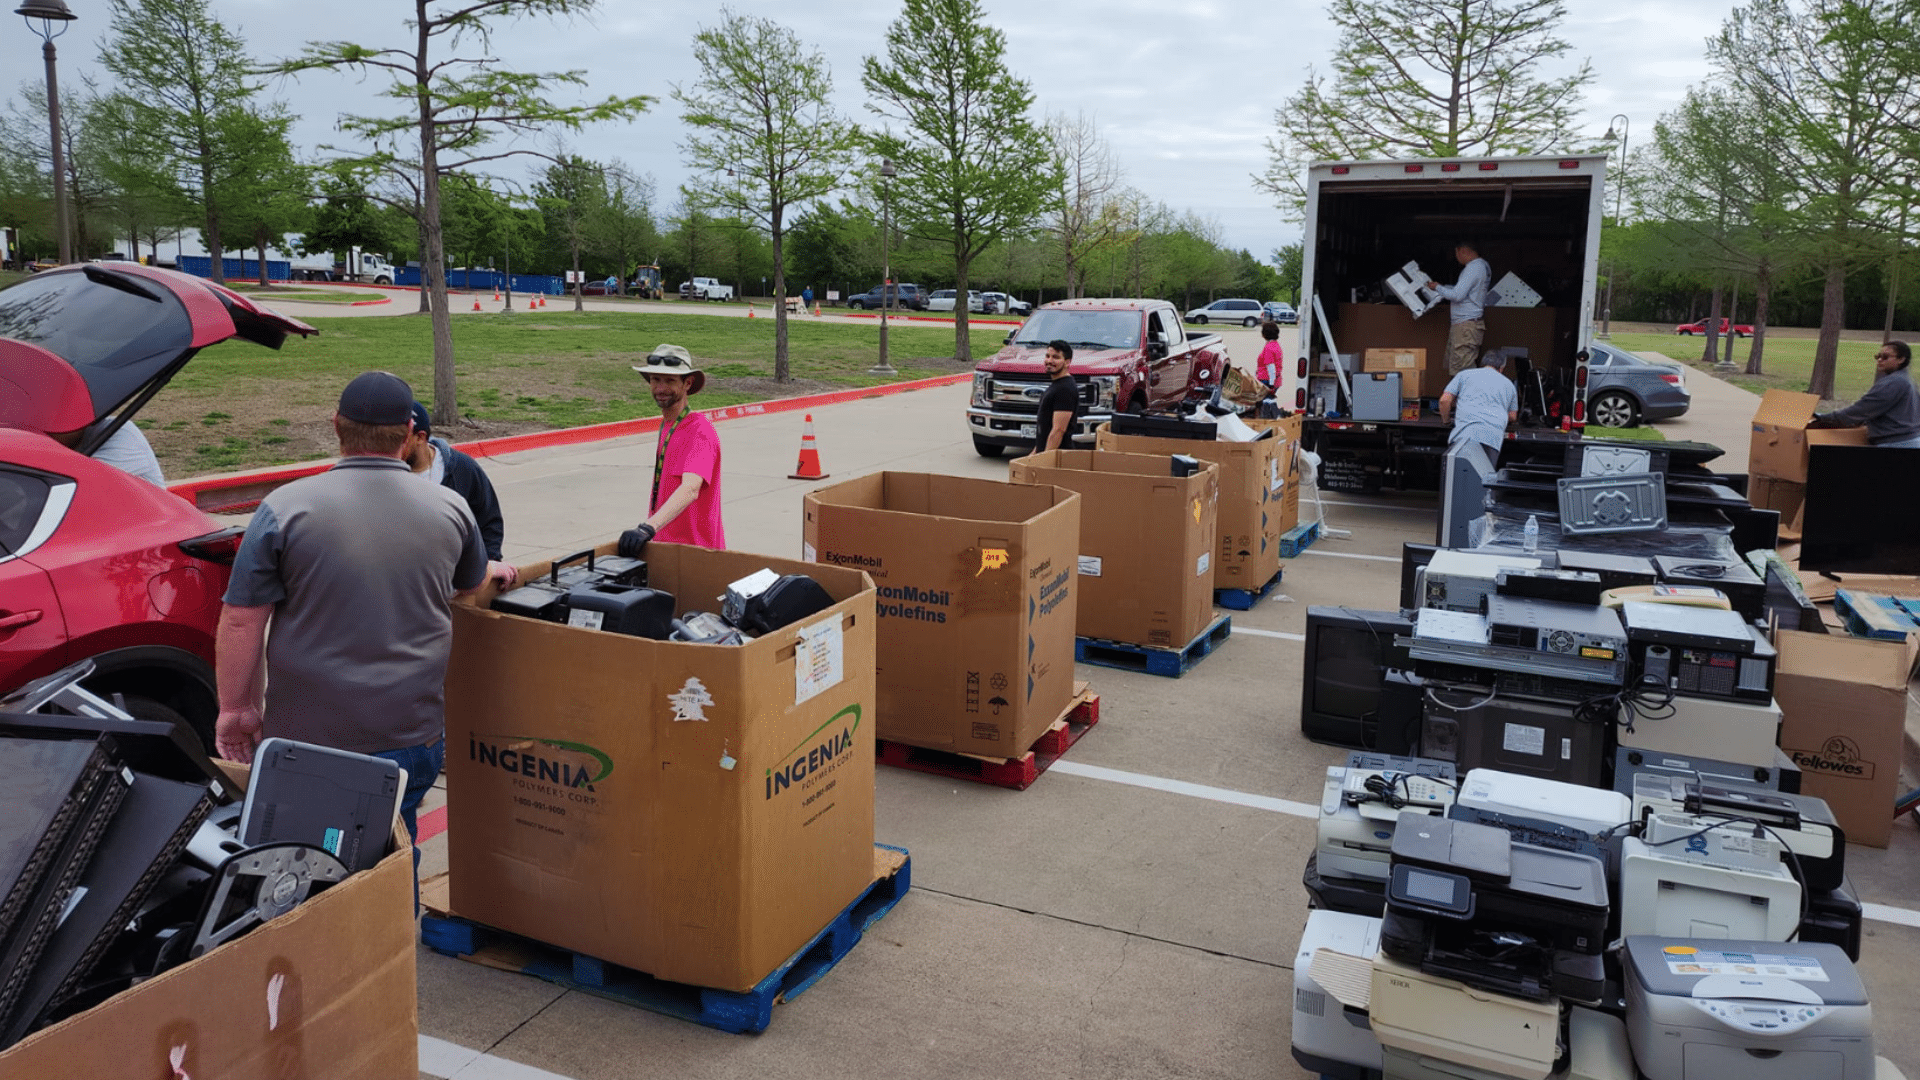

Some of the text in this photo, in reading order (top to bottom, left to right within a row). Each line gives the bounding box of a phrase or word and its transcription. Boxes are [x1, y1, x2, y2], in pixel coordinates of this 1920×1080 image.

[826, 551, 882, 568] ExxonMobil
[876, 584, 950, 606] xonMobil
[1040, 565, 1070, 601] ExxonMobil
[876, 600, 947, 624] lyolefins
[1039, 586, 1069, 618] Polyolefins
[469, 731, 595, 793] INGENIA
[765, 726, 854, 801] INGENIA
[1792, 751, 1864, 776] Fellowes
[512, 778, 565, 799] POLYMERS
[801, 762, 836, 792] POLYMERS
